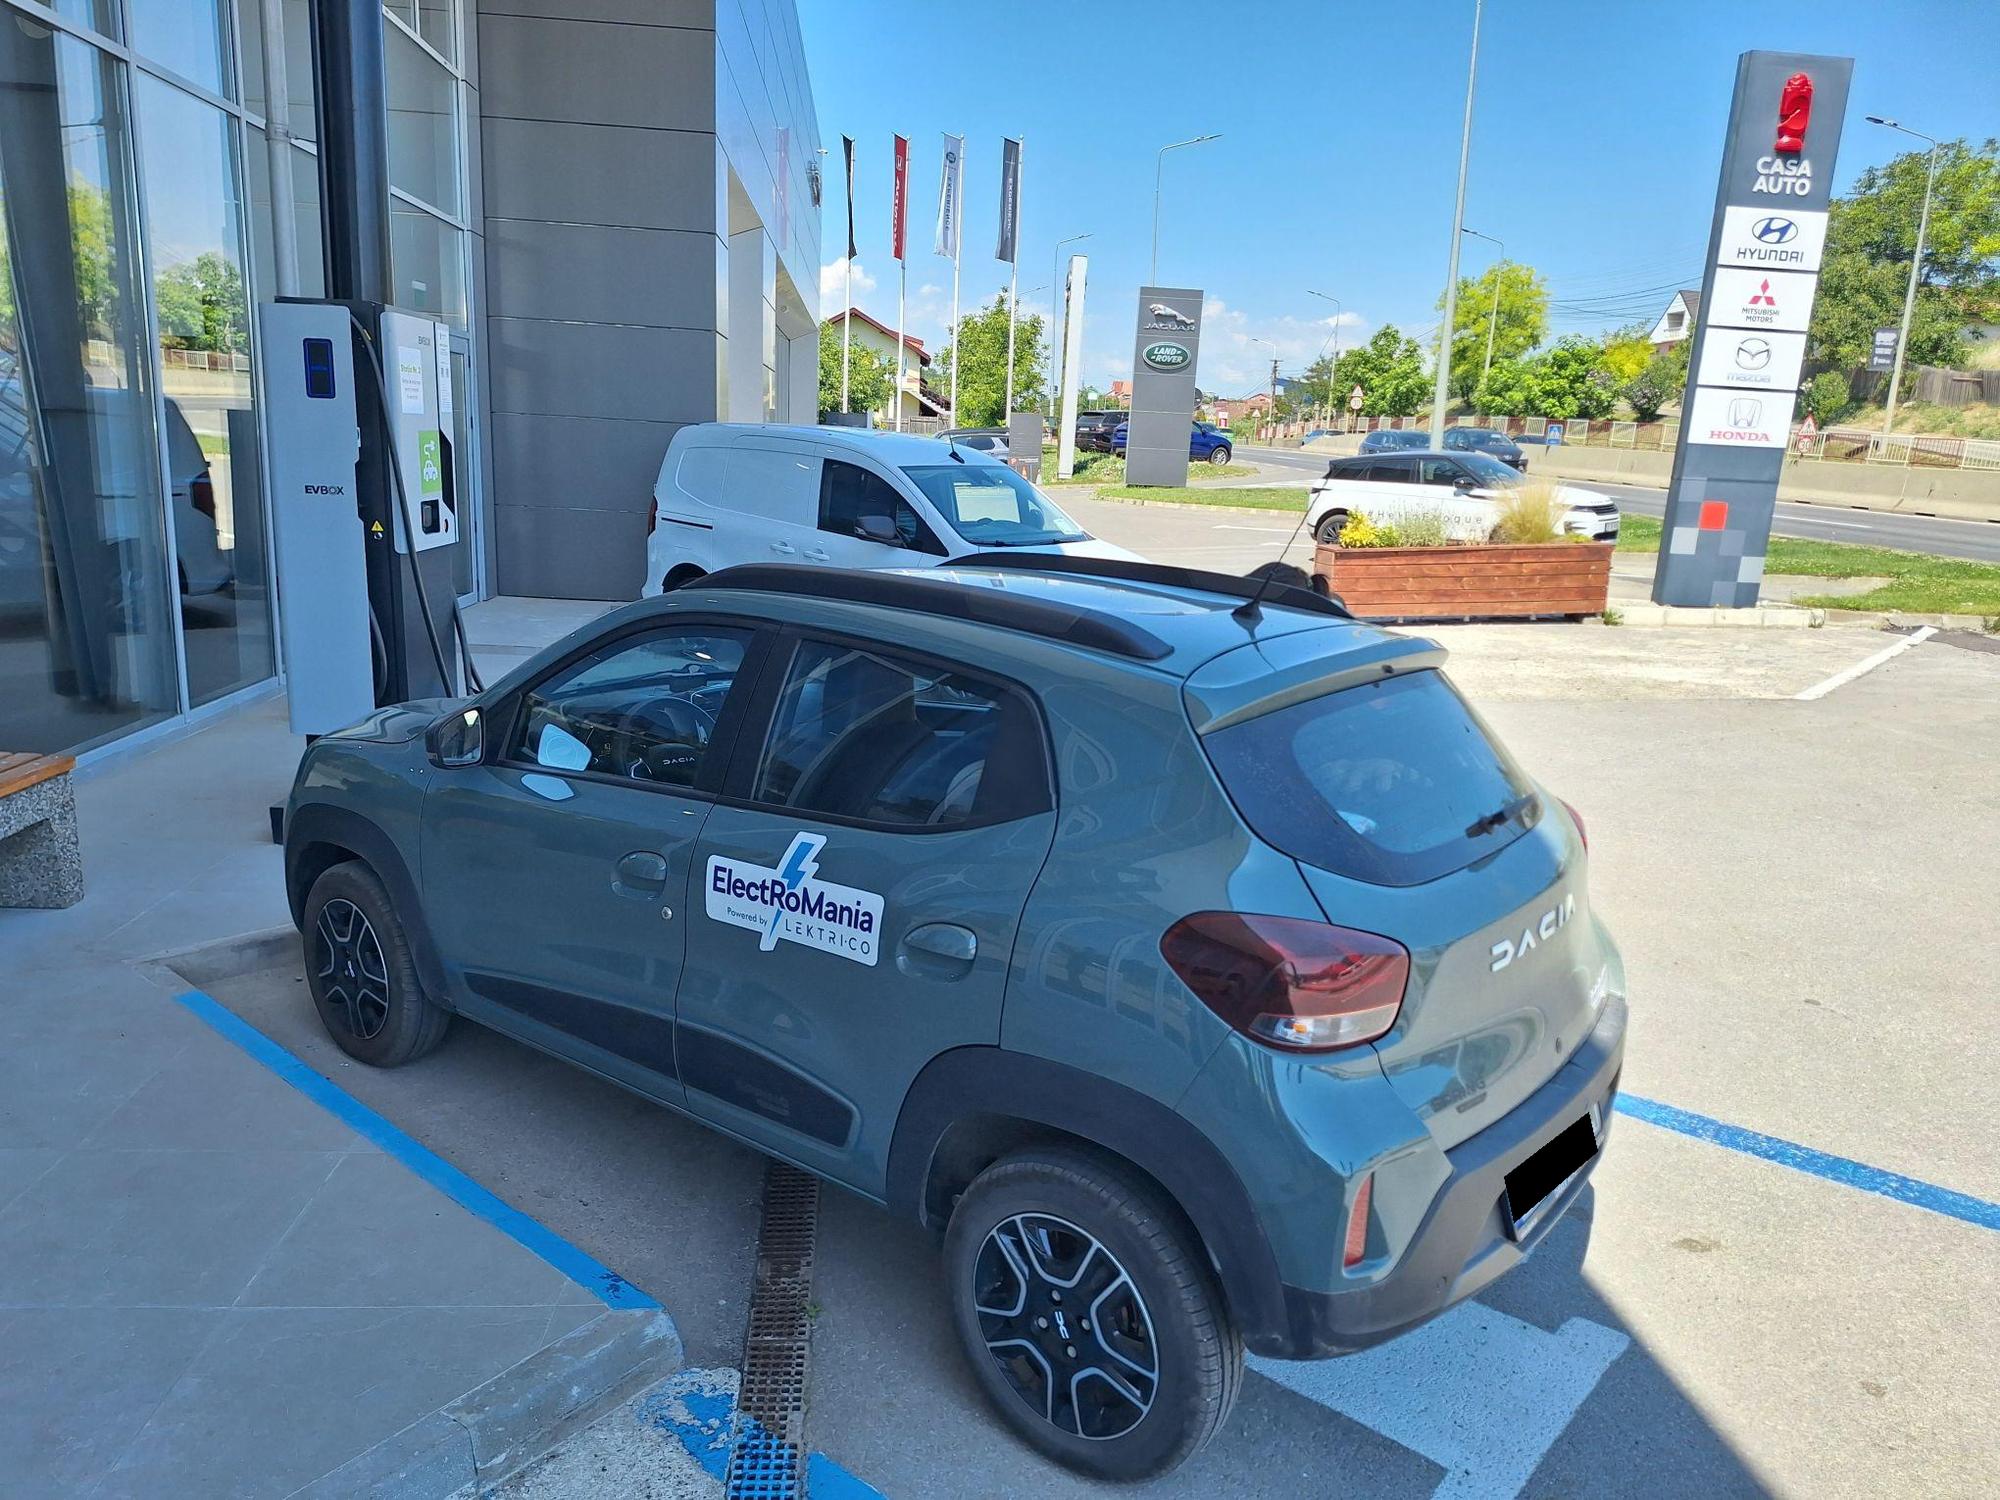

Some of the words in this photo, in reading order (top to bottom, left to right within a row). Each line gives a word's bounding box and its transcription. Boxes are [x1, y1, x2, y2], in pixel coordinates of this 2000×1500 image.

[1756, 156, 1812, 177] CASA
[1752, 176, 1811, 196] AUTO
[1736, 247, 1804, 263] HYUNDAI
[1742, 307, 1780, 316] MITSUBISHI
[1745, 315, 1774, 323] MOTORS
[1143, 322, 1196, 332] JAGUAR
[1153, 347, 1177, 355] LAND
[1155, 355, 1183, 363] ROVER
[1709, 430, 1771, 441] HONDA
[305, 485, 344, 495] EVBOX
[662, 757, 695, 765] DACIA
[712, 865, 874, 933] ElectRoMania
[727, 906, 758, 922] Powered
[759, 914, 768, 926] by
[1490, 893, 1576, 973] DACIA
